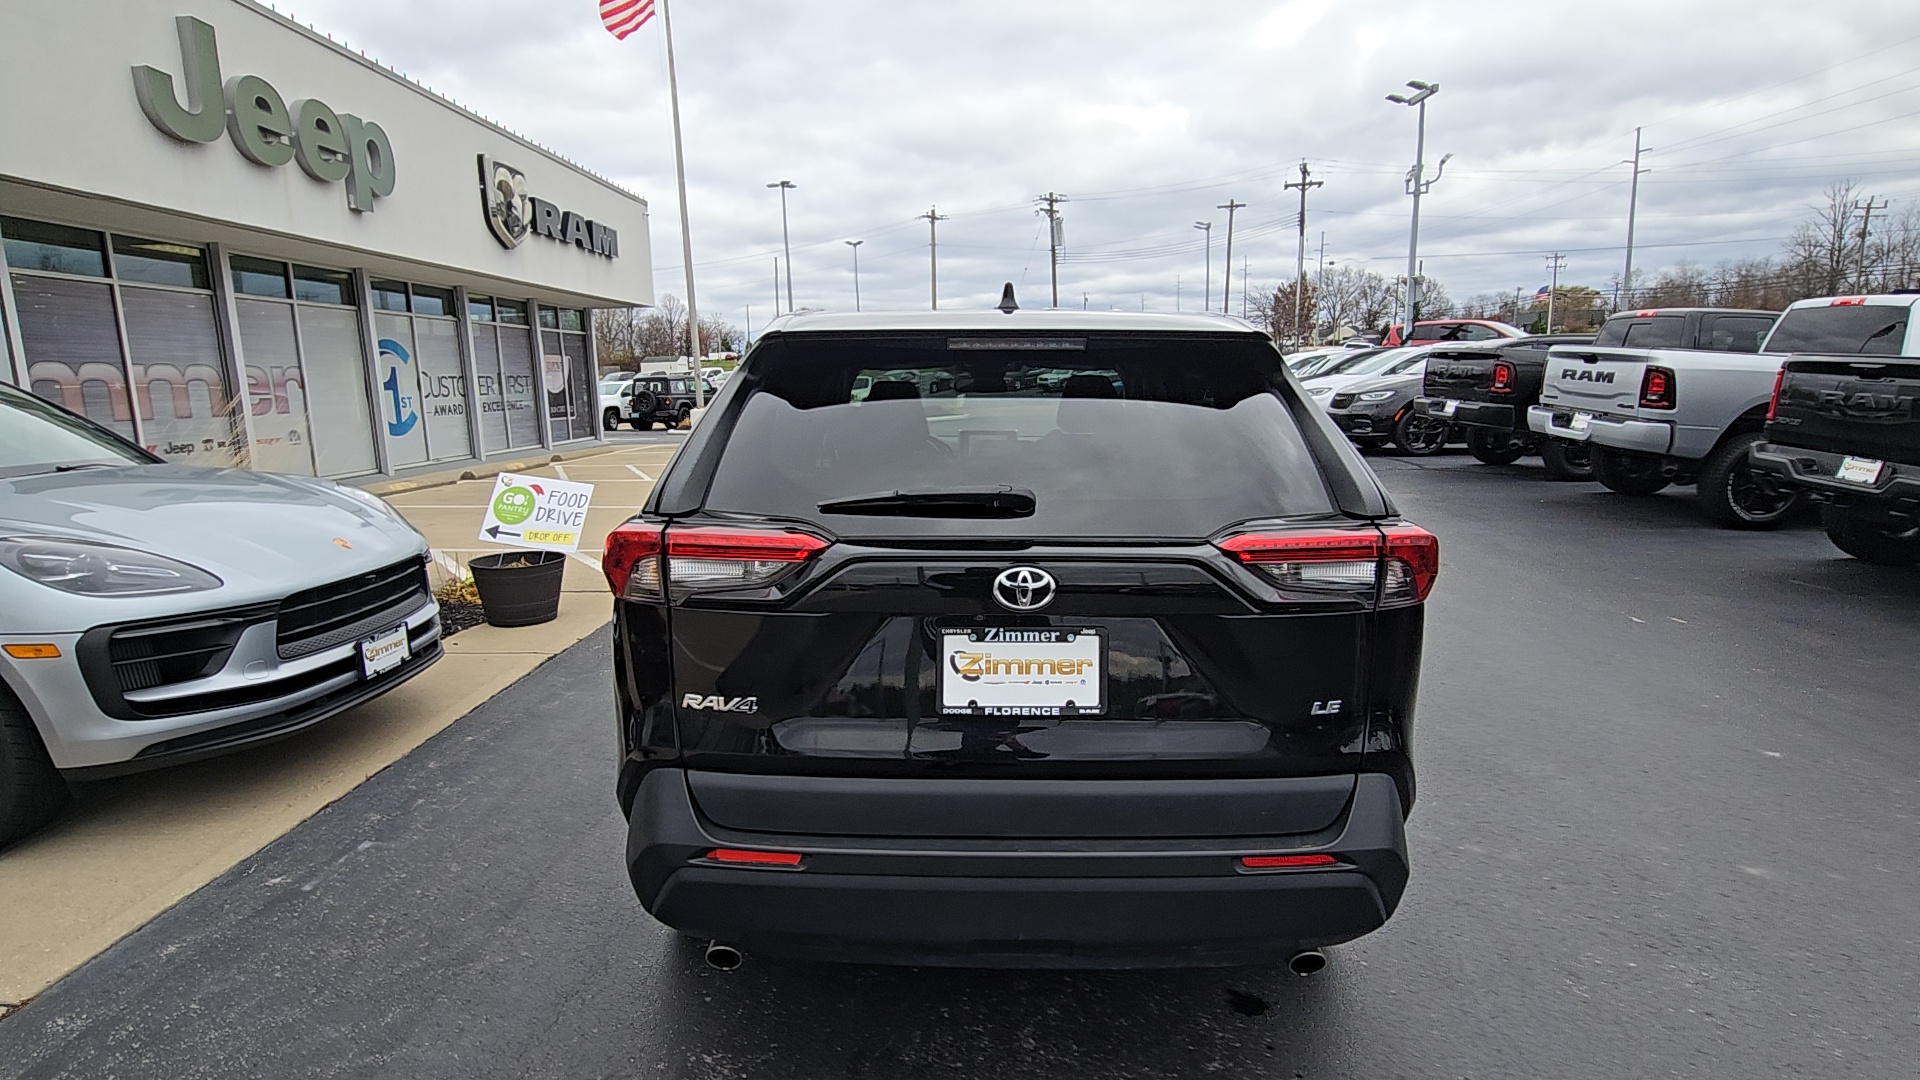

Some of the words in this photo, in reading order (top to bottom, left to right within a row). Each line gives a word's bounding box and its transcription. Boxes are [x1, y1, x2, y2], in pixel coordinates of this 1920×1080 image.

[131, 15, 396, 214] Jeep
[530, 197, 620, 258] RAM
[1561, 368, 1616, 384] RAM
[417, 370, 496, 399] CUSTOER
[497, 372, 531, 396] FRST
[433, 404, 464, 416] AWARD
[482, 400, 525, 413] EXCELENCE
[164, 441, 195, 455] Jeep
[502, 491, 530, 506] GO!
[547, 490, 589, 509] FOOD
[497, 503, 530, 517] PANTRY
[535, 506, 585, 527] DRIVE
[528, 531, 551, 541] DROP
[552, 533, 571, 542] OFF
[984, 627, 1061, 642] Zimmer
[368, 637, 406, 660] Zimmer
[958, 652, 1094, 676] Zimmer
[681, 693, 759, 714] RAV4
[942, 707, 973, 715] DODGE
[984, 707, 1061, 716] FLORENCE
[1310, 699, 1342, 716] LE
